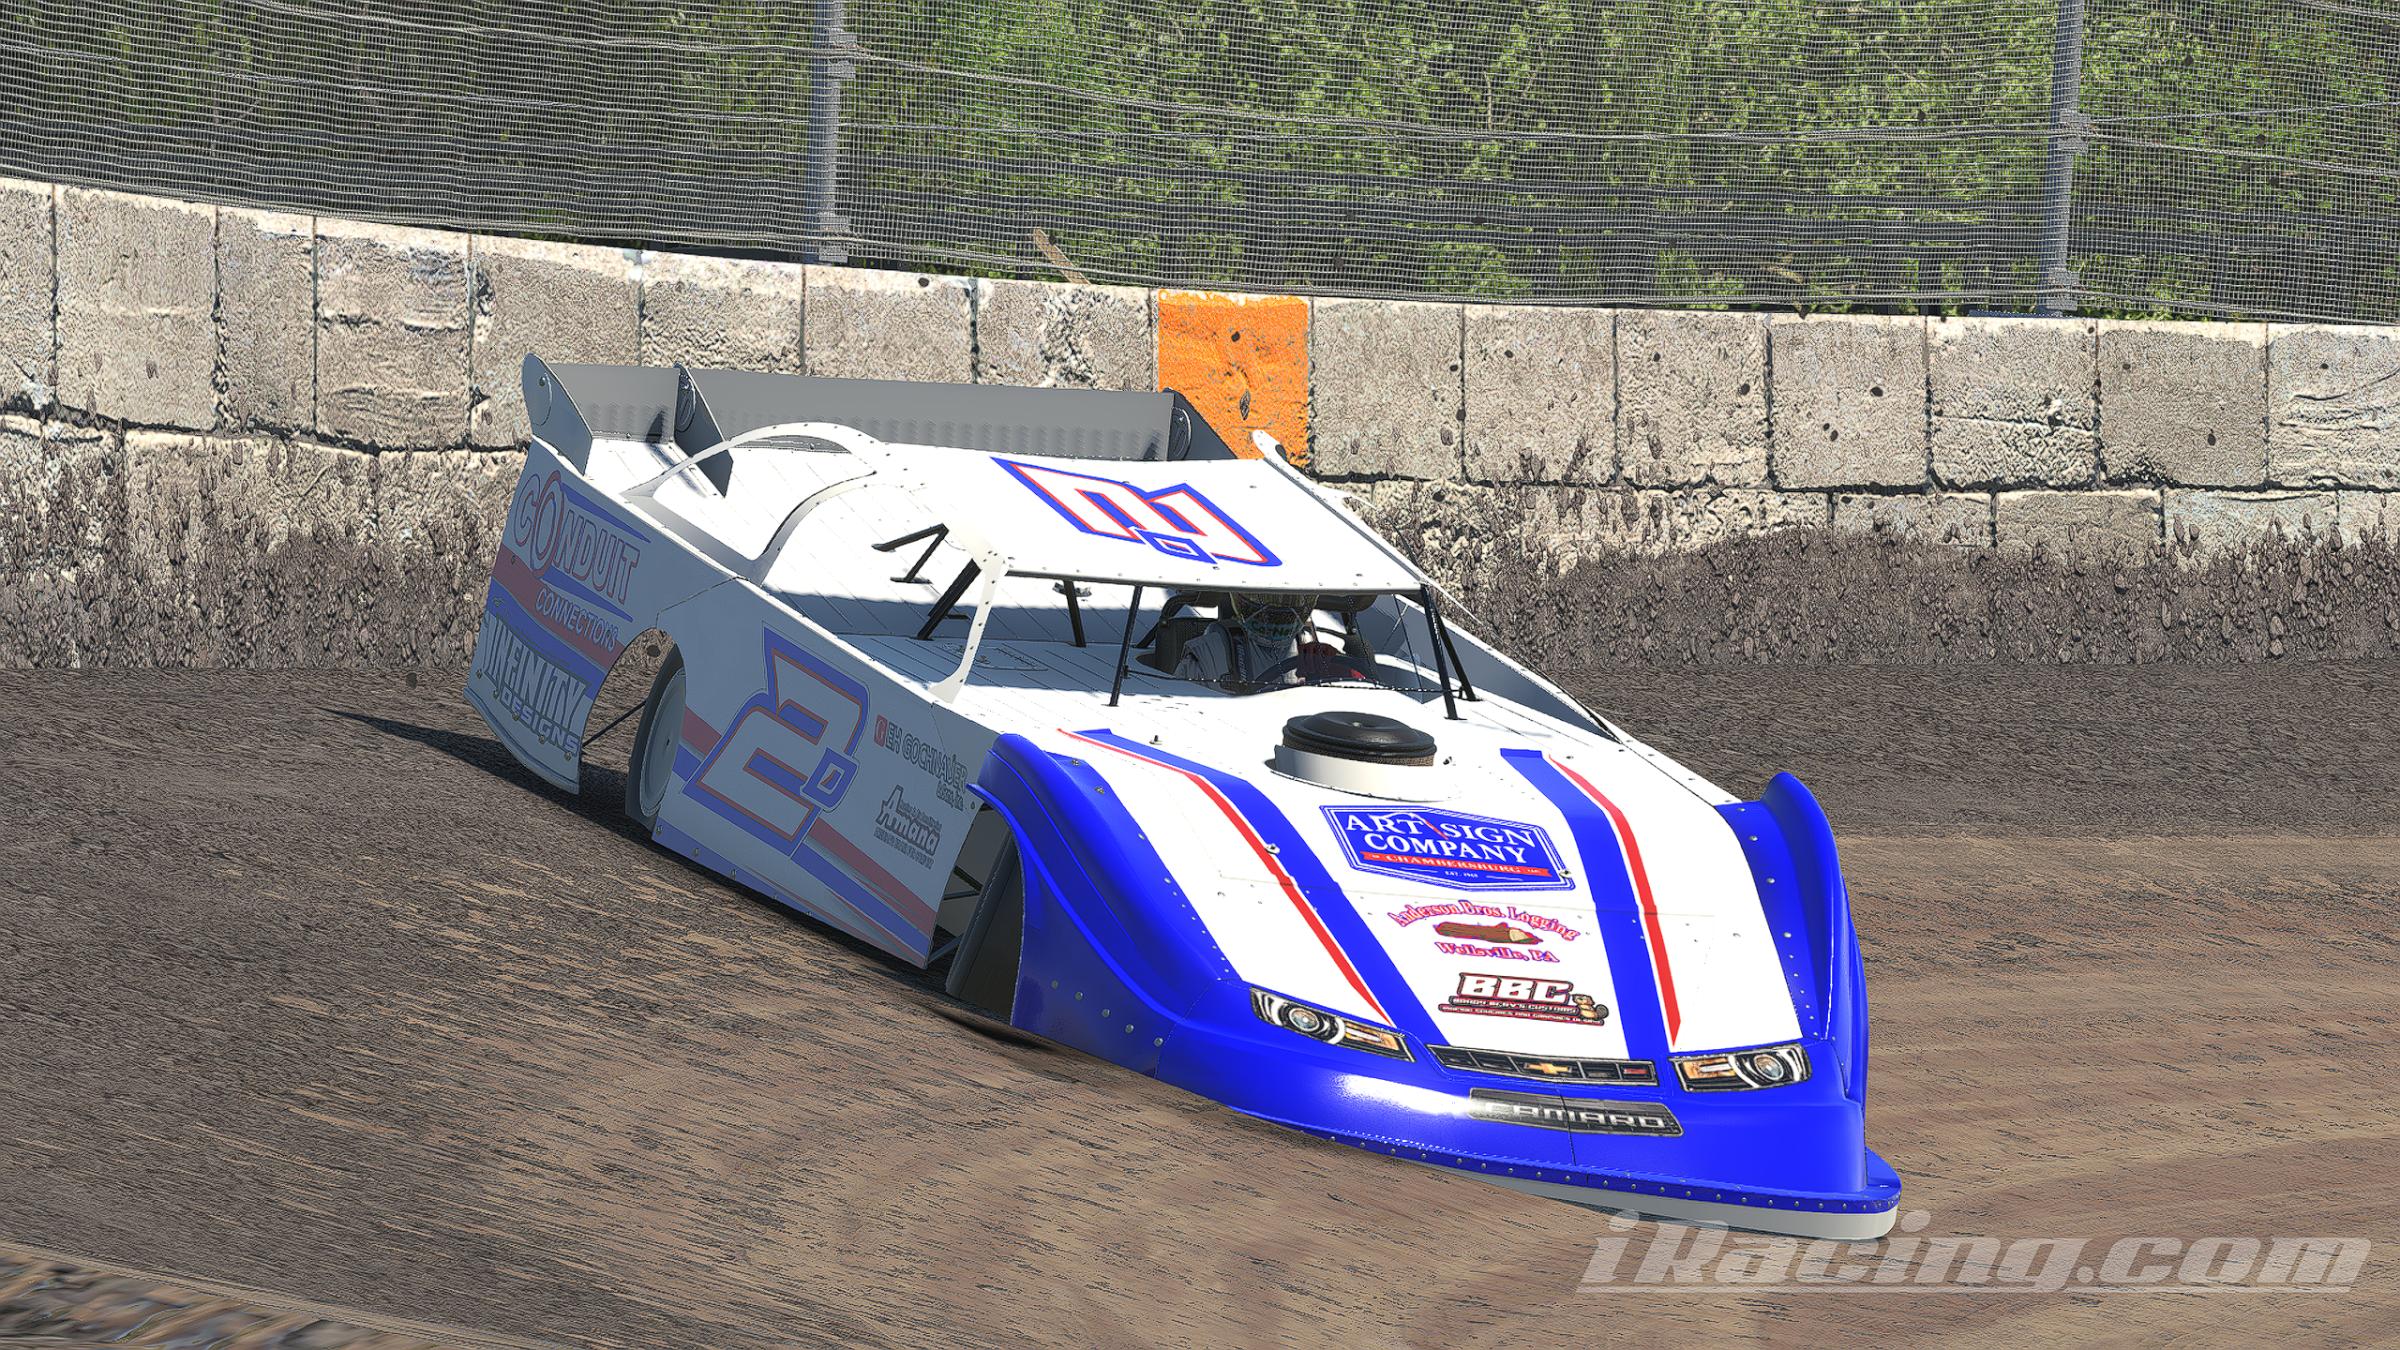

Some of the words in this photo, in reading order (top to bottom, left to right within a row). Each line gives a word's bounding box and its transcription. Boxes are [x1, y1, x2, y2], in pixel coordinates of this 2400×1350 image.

[513, 470, 640, 606] CONDUIT
[535, 587, 619, 653] CONNECTIONS
[500, 692, 581, 757] DESIGNS
[875, 784, 941, 857] Amana
[1347, 813, 1425, 836] ART
[1439, 823, 1537, 849] SIGN
[1363, 833, 1528, 864] COMPANY
[1385, 855, 1522, 874] CHAMBERSBURG
[1388, 904, 1461, 927] Anderson
[1458, 899, 1507, 918] Bros.
[1507, 906, 1581, 941] Logging
[1434, 941, 1530, 961] Wellsville,
[1528, 949, 1561, 963] PA
[1457, 972, 1574, 1005] BBC
[1485, 1102, 1666, 1129] CAMARO
